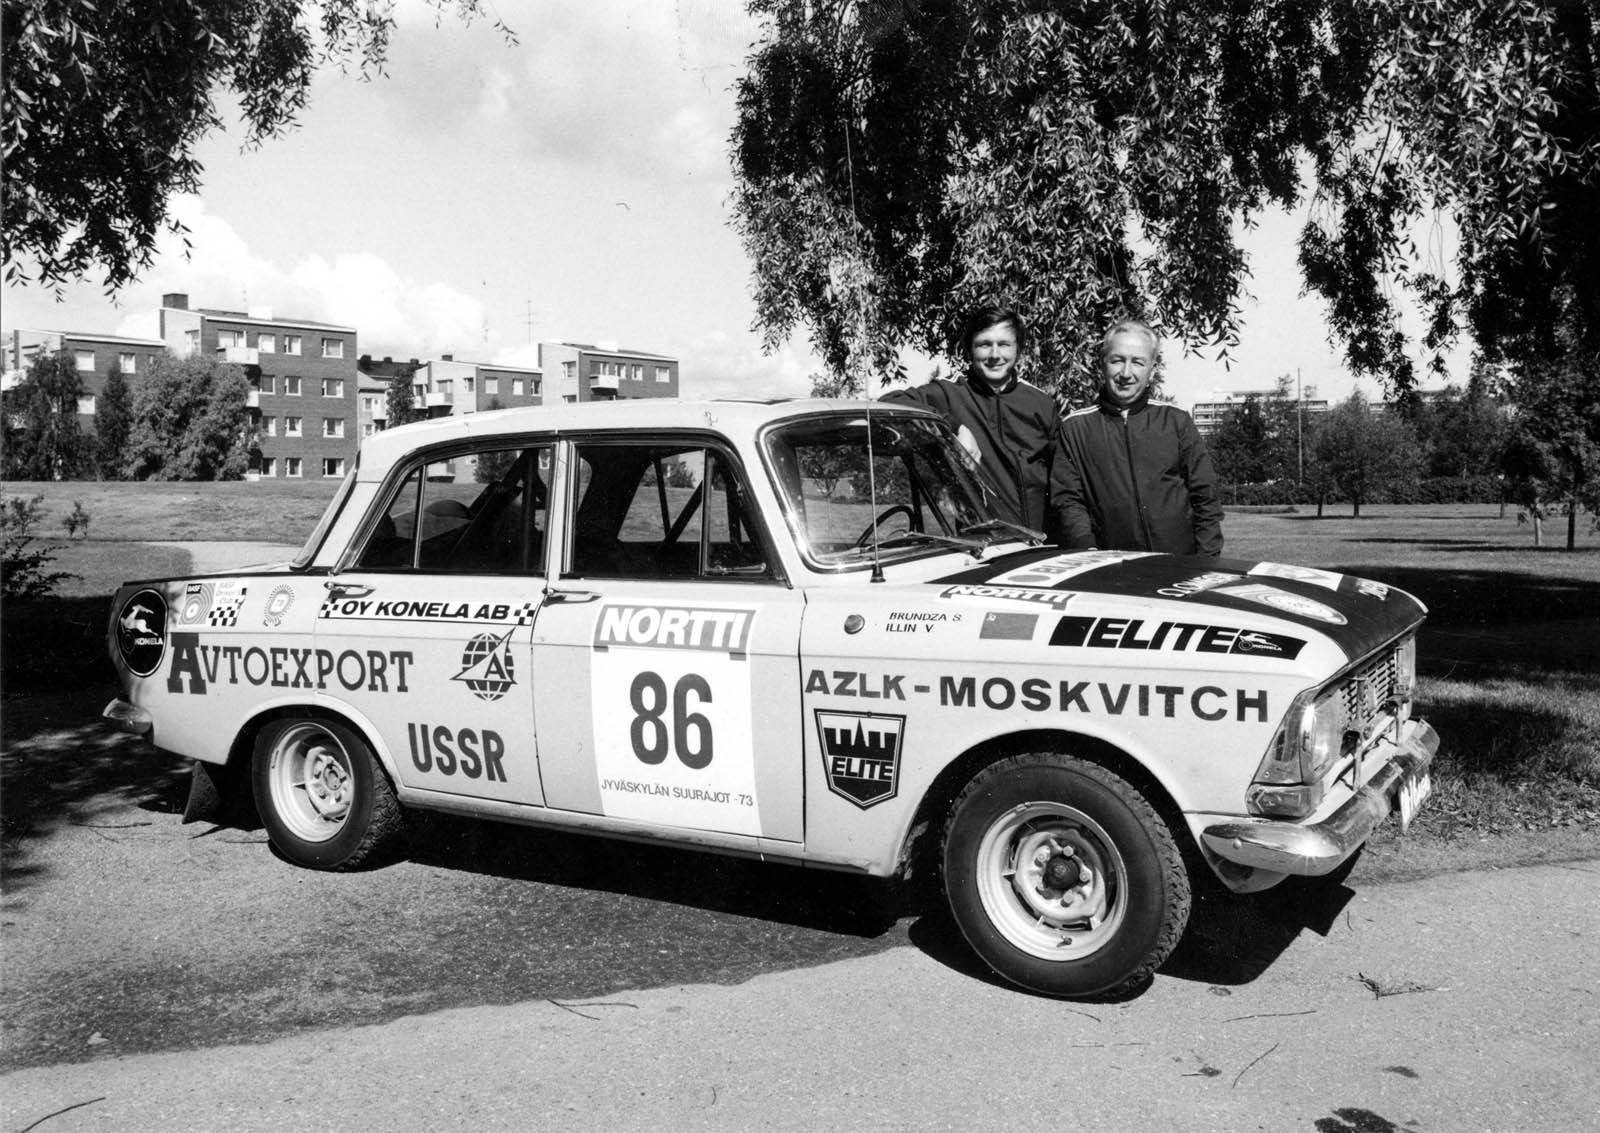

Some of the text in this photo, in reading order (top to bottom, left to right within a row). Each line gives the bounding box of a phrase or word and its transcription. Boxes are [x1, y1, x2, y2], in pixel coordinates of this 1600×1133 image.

[948, 585, 1071, 603] NORTTI
[341, 600, 510, 620] OY KONELA AB
[889, 612, 947, 622] BRUNDZA
[599, 607, 748, 648] NORTTI
[886, 623, 935, 633] ILLIN V
[1086, 617, 1241, 654] ELITE
[134, 637, 164, 646] KONELA
[167, 632, 413, 695] AVTOEXPORT
[629, 670, 713, 770] 86
[407, 722, 508, 783] USSR
[830, 756, 894, 781] ELITE
[601, 778, 670, 797] JYVÄSKYLÄN
[672, 786, 731, 804] SUURAJOT
